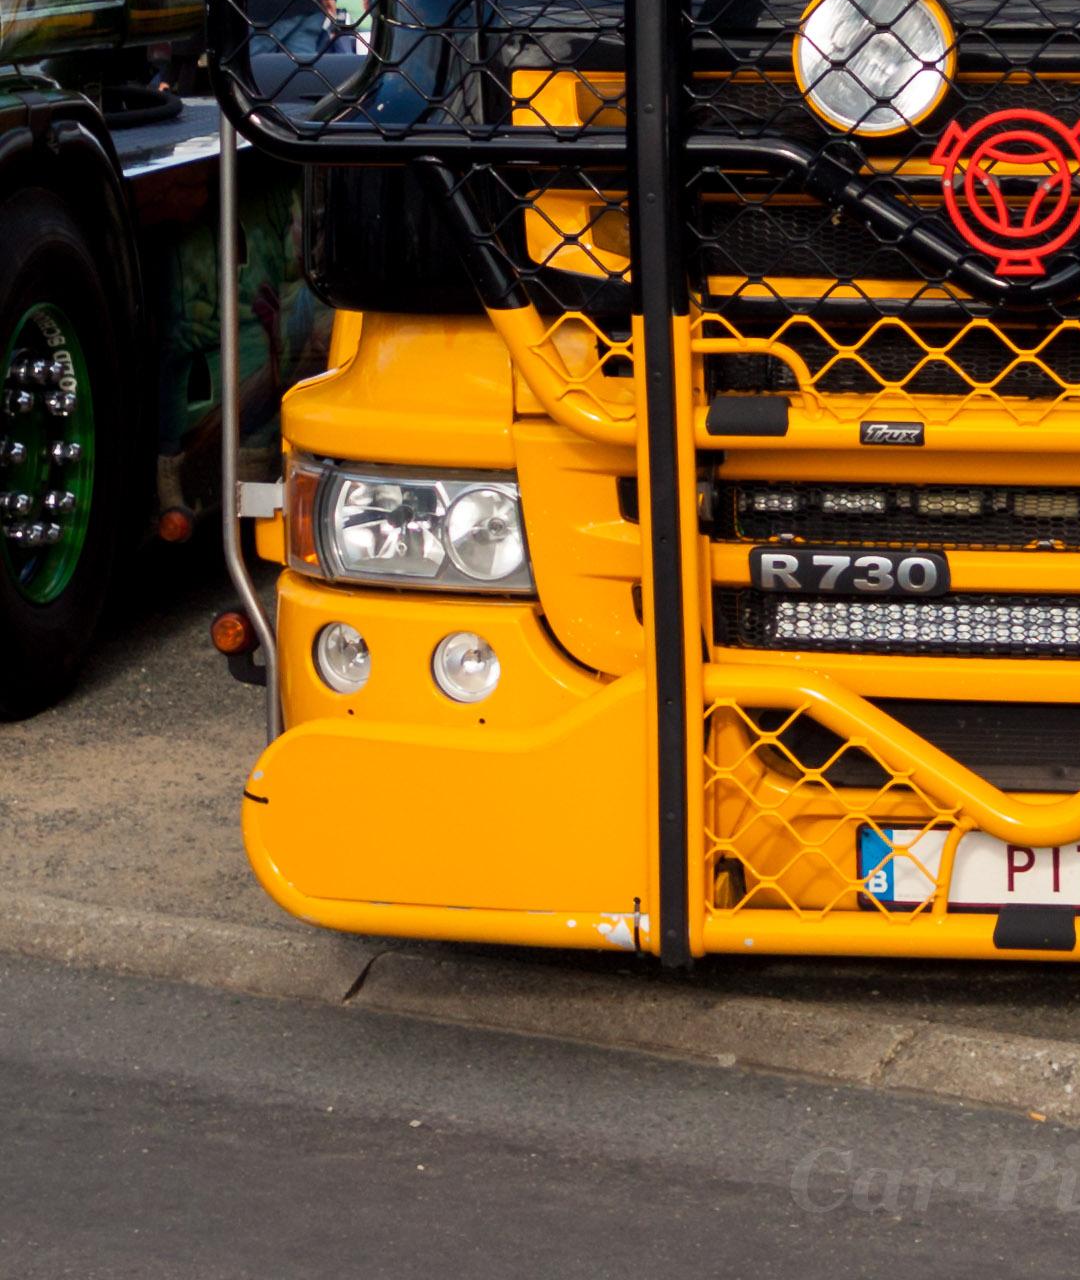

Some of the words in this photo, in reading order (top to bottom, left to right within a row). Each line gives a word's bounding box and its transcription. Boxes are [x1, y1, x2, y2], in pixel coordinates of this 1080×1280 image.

[864, 424, 920, 442] Trux
[761, 553, 802, 589] R
[812, 554, 938, 593] 730
[868, 870, 889, 893] B
